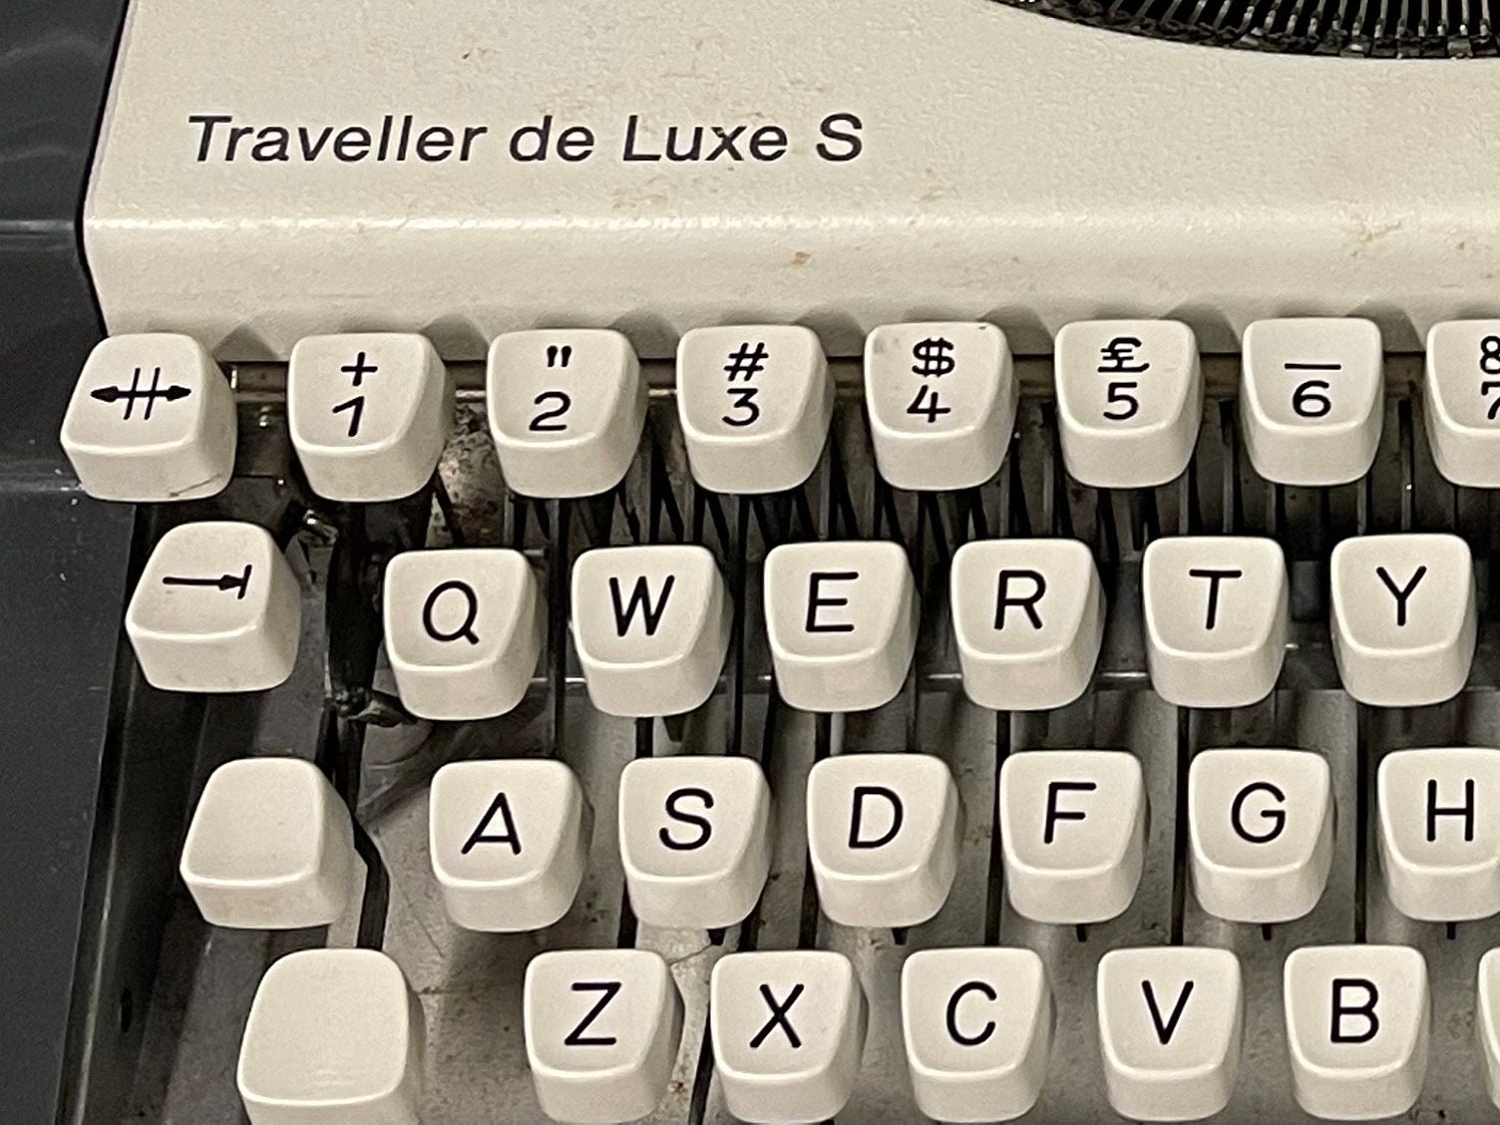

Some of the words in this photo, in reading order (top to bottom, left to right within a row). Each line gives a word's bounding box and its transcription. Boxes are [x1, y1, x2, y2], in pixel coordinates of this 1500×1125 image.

[188, 114, 488, 163] Traveller
[509, 114, 595, 162] de
[622, 114, 788, 162] Luxe
[815, 112, 863, 162] S
[340, 351, 379, 387] +
[723, 342, 769, 382] #
[911, 337, 956, 378] $
[1097, 336, 1150, 373] £
[332, 395, 365, 438] 1
[528, 391, 571, 432] 2
[721, 387, 760, 427] 3
[906, 384, 952, 424] 4
[1102, 381, 1139, 421] 5
[1292, 380, 1332, 418] 6
[422, 580, 480, 646] Q
[608, 574, 676, 638] W
[805, 571, 860, 633] E
[993, 569, 1047, 631] R
[1188, 568, 1243, 631] T
[1375, 565, 1427, 627] Y
[460, 792, 522, 856] A
[658, 787, 714, 851] S
[848, 786, 904, 849] D
[1043, 781, 1097, 845] F
[1231, 781, 1286, 844] G
[1426, 778, 1475, 843] H
[563, 981, 622, 1047] Z
[749, 983, 805, 1049] X
[946, 981, 998, 1047] C
[1141, 980, 1194, 1045] V
[1330, 978, 1380, 1044] B
